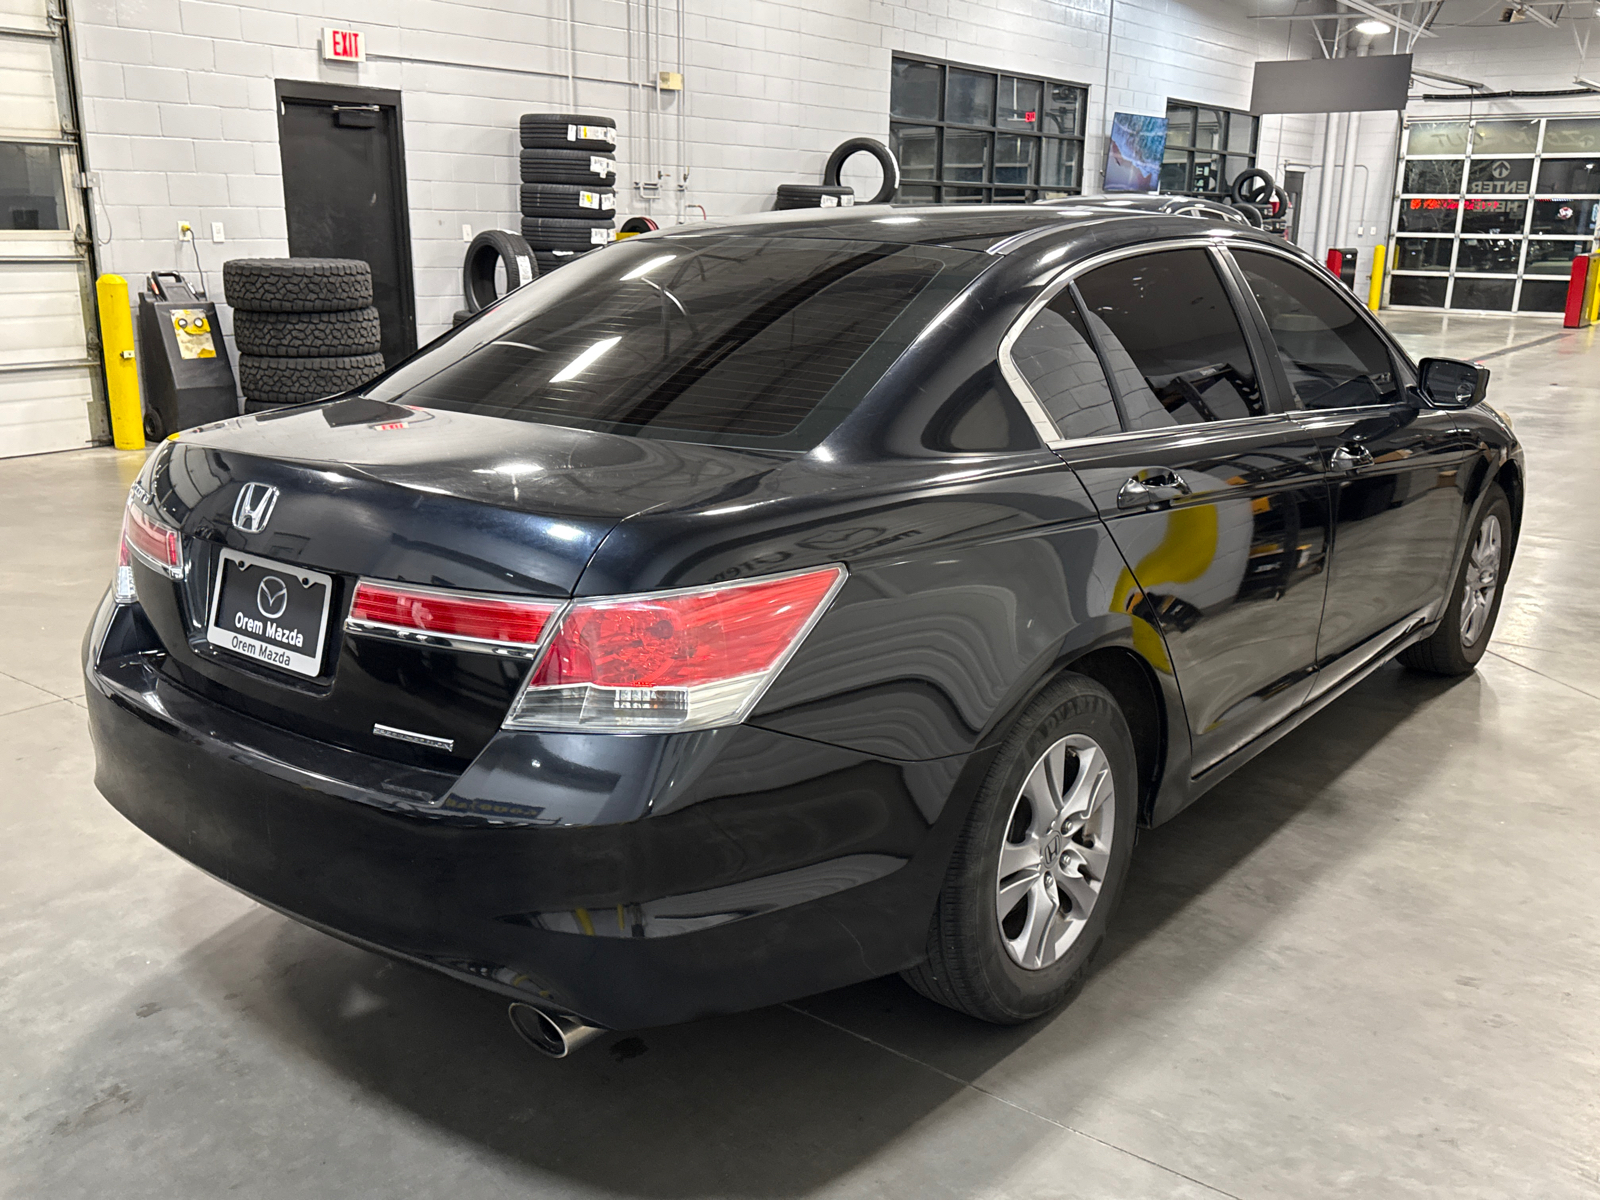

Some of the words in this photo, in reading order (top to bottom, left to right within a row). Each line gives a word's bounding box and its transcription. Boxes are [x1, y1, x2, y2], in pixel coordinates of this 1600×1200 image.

[332, 30, 359, 58] EXIT
[235, 611, 264, 636] Orem
[265, 621, 304, 648] Mazda
[231, 635, 256, 655] Orem
[258, 642, 291, 667] Mazda
